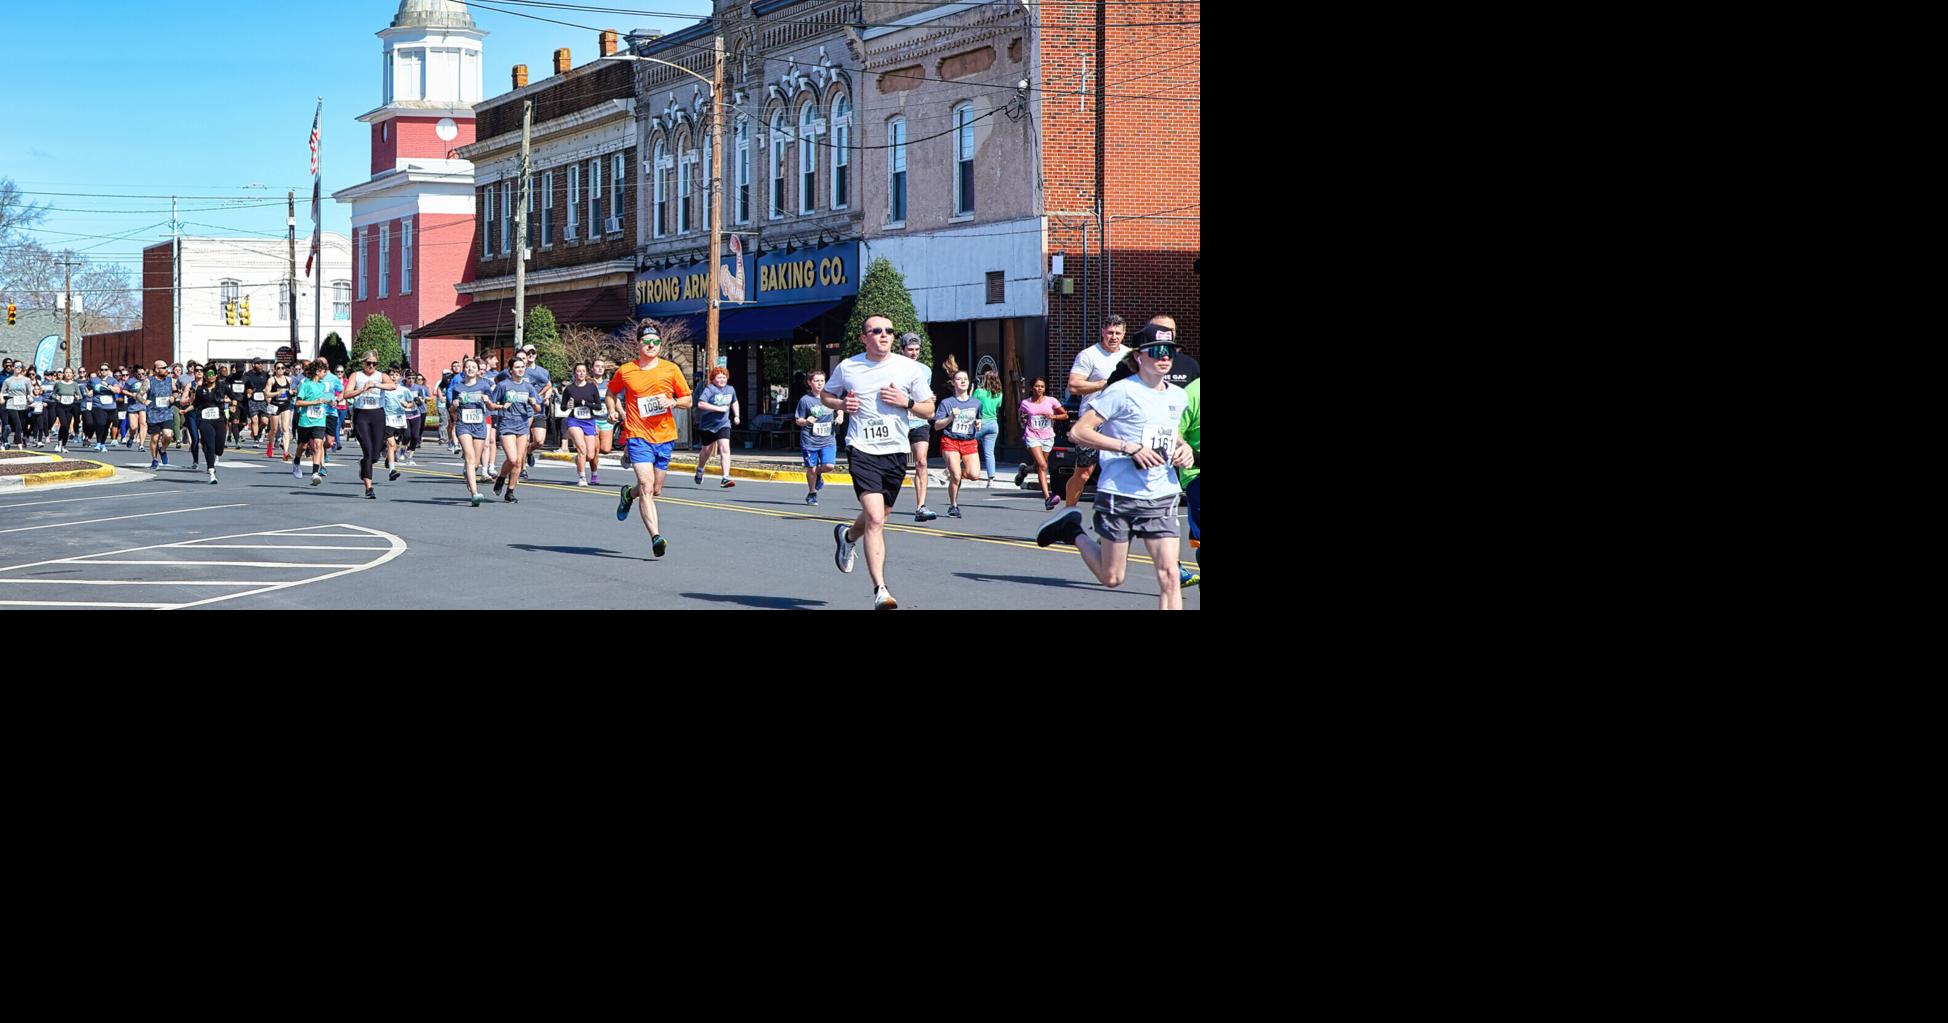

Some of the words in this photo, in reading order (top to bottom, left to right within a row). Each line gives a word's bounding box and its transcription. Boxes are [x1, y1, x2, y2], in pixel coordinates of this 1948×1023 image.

[760, 259, 816, 292] BAKING
[820, 255, 846, 287] CO.
[635, 276, 680, 305] STRONG
[683, 272, 710, 300] ARM
[863, 425, 889, 439] 1149
[1151, 436, 1174, 453] 1161
